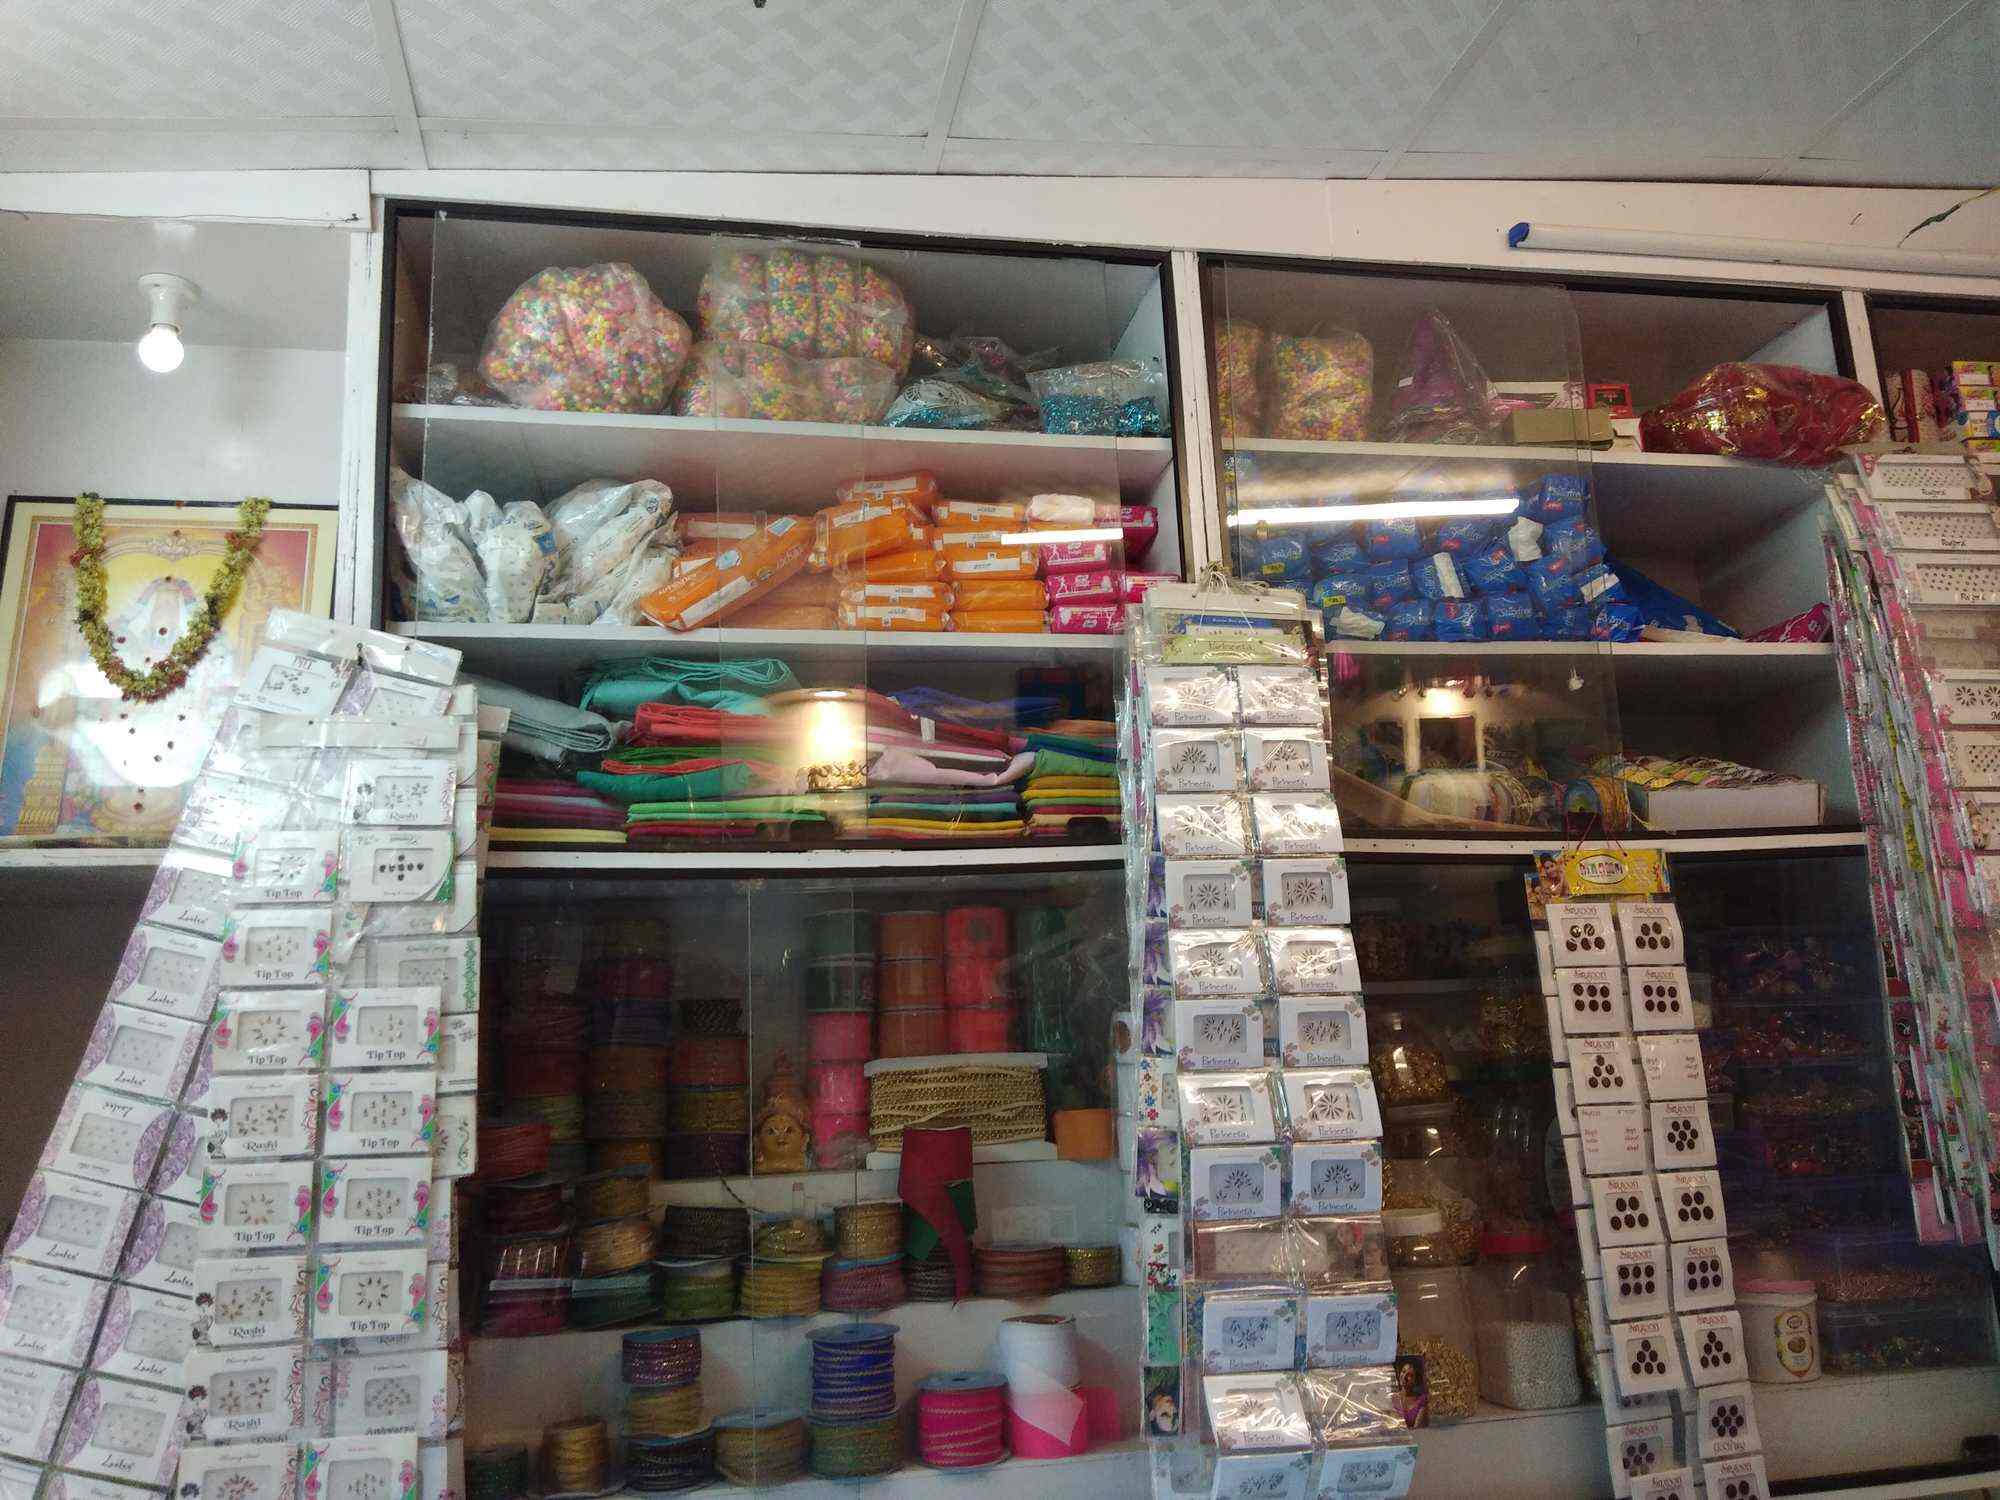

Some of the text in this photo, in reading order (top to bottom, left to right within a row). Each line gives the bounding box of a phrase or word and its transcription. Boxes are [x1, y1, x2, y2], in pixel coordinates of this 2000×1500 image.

[264, 887, 303, 899] Tip Top
[254, 969, 295, 980] Tip Top
[247, 1054, 288, 1065] Tip Top
[366, 1049, 406, 1061] Tip Top
[360, 1137, 400, 1149] Tip Top
[353, 1224, 395, 1236] Tip Top
[233, 1231, 277, 1243] Tip Top
[350, 1319, 391, 1332] Tip Top
